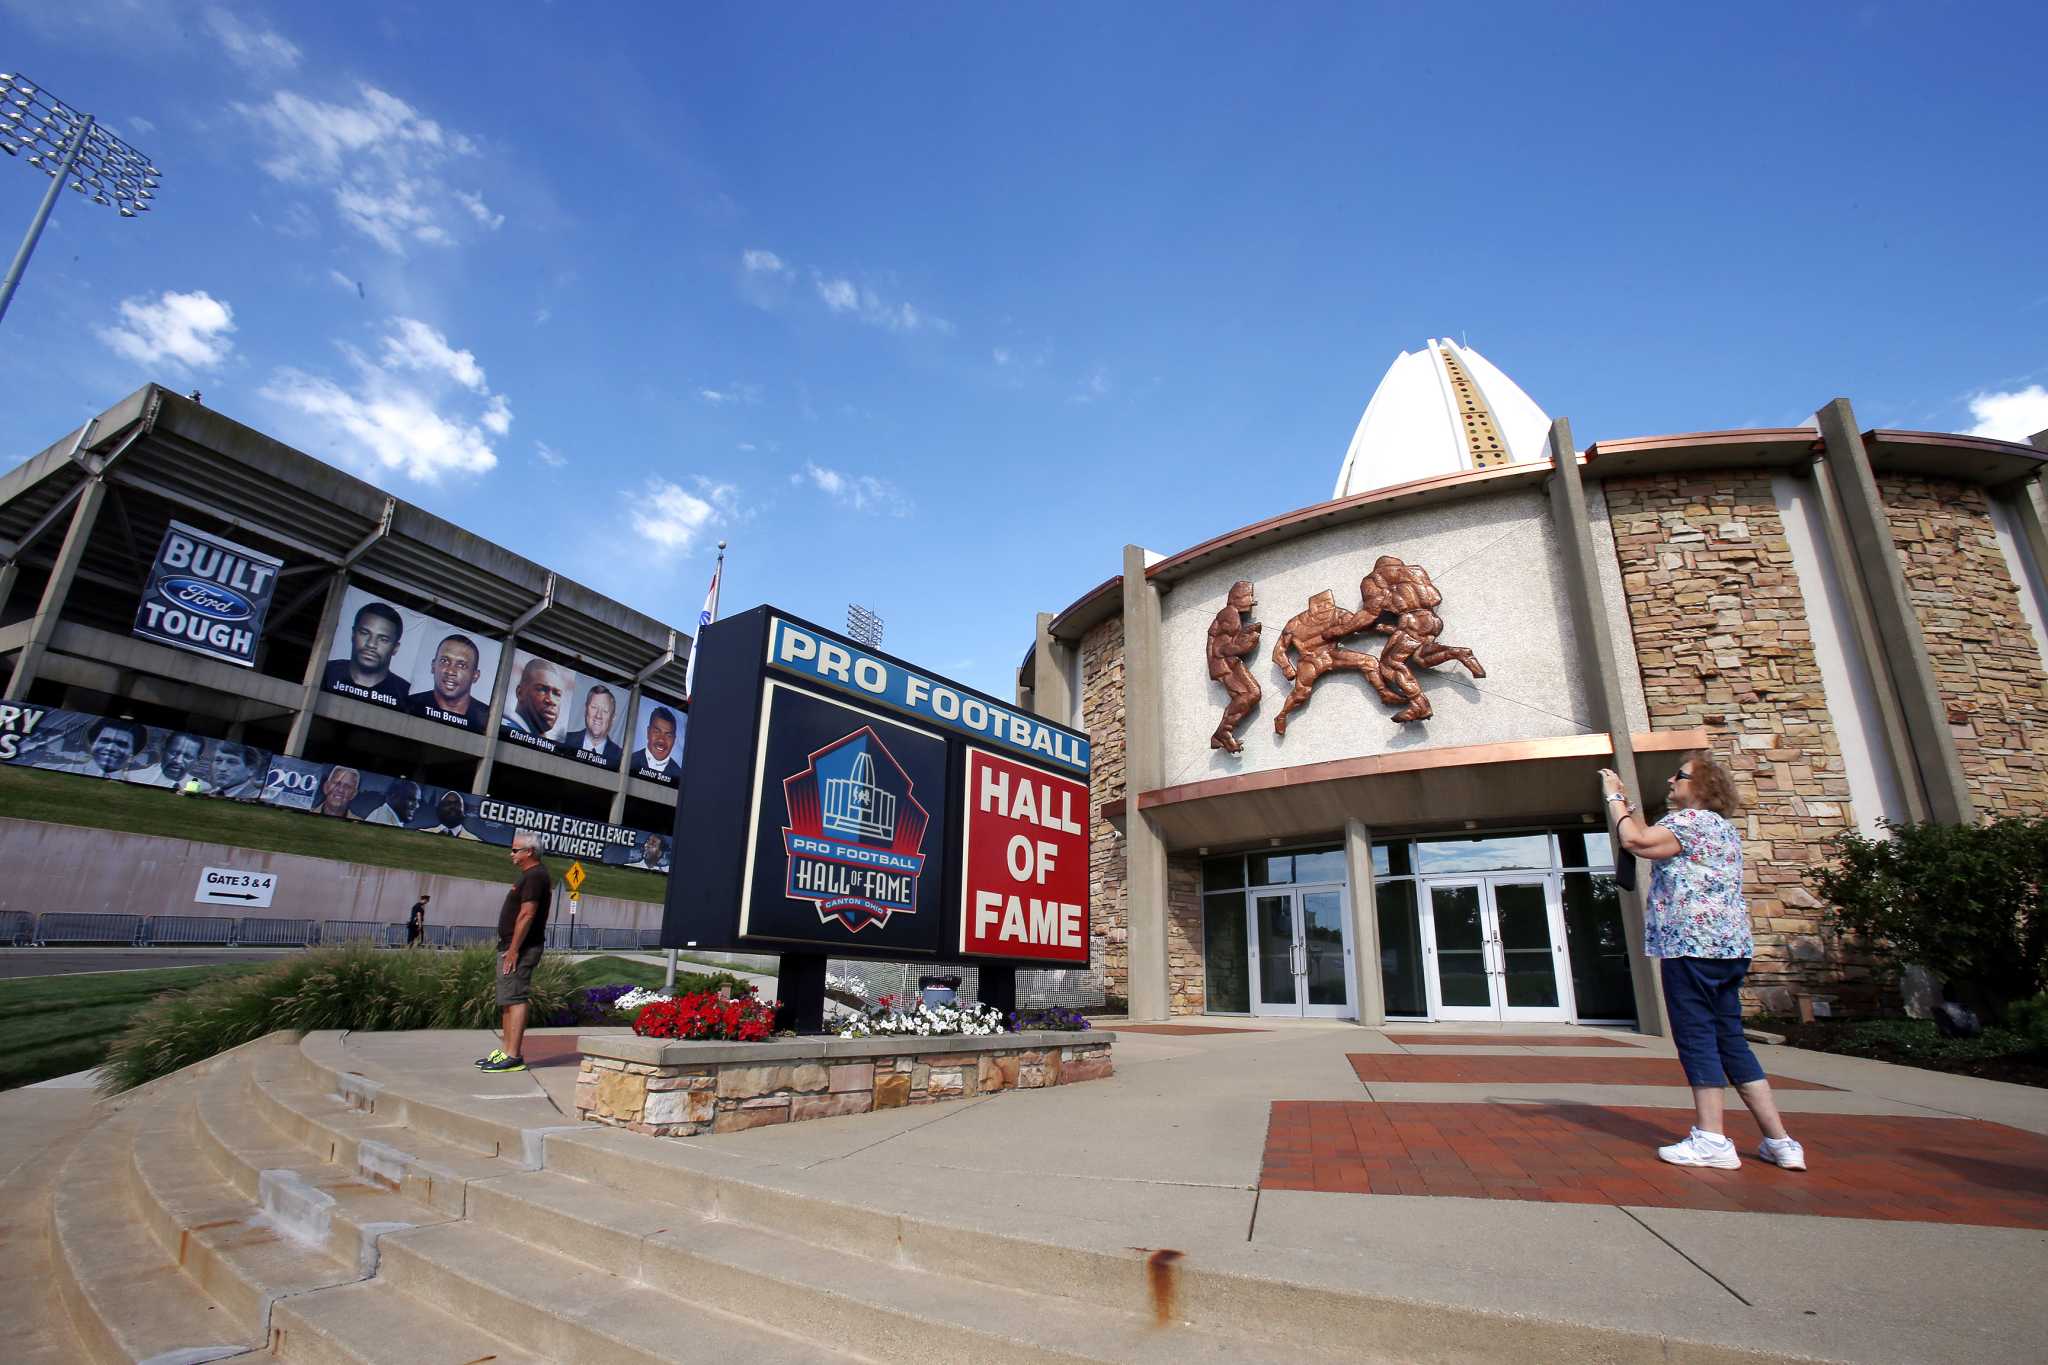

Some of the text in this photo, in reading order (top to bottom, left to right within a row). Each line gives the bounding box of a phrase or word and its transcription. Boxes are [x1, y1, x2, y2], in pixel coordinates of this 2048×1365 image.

[163, 533, 274, 595] BUILT
[179, 583, 235, 613] Ford
[146, 601, 254, 655] TOUGH
[333, 680, 398, 706] Jerome Bettis
[780, 626, 1087, 768] PRO FOOTBALL
[425, 706, 468, 727] Tim Brown
[510, 729, 557, 752] Charles Haley
[577, 749, 588, 760] Bill
[266, 768, 319, 792] 200
[639, 767, 657, 779] Junior
[979, 765, 1082, 836] HALL
[480, 801, 637, 847] CELEBRATE EXCELLENCE
[515, 823, 604, 859] RYWHERE
[793, 838, 916, 870] PRO FOOTBALL
[1006, 834, 1059, 885] OF
[207, 872, 271, 889] GATE 3 & 4
[796, 859, 912, 904] HALL OF FAME
[864, 901, 883, 914] OHIO
[974, 889, 1083, 948] FAME
